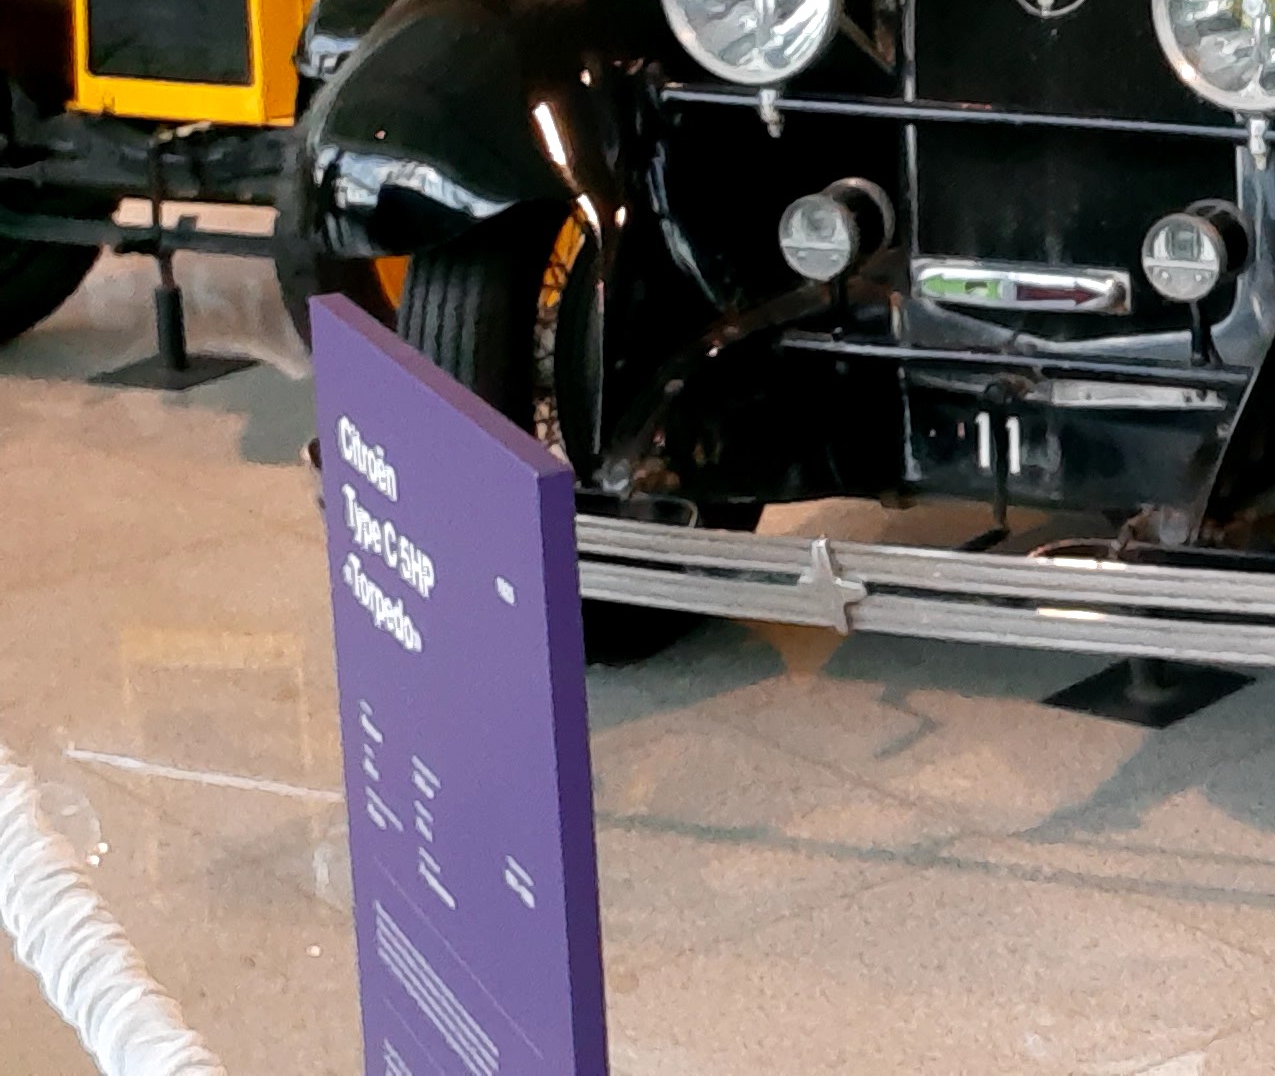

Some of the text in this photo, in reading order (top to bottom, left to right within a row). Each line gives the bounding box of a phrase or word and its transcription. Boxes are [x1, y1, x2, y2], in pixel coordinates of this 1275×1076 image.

[337, 415, 398, 502] Citroën
[341, 483, 382, 555] Type
[383, 521, 398, 569] C
